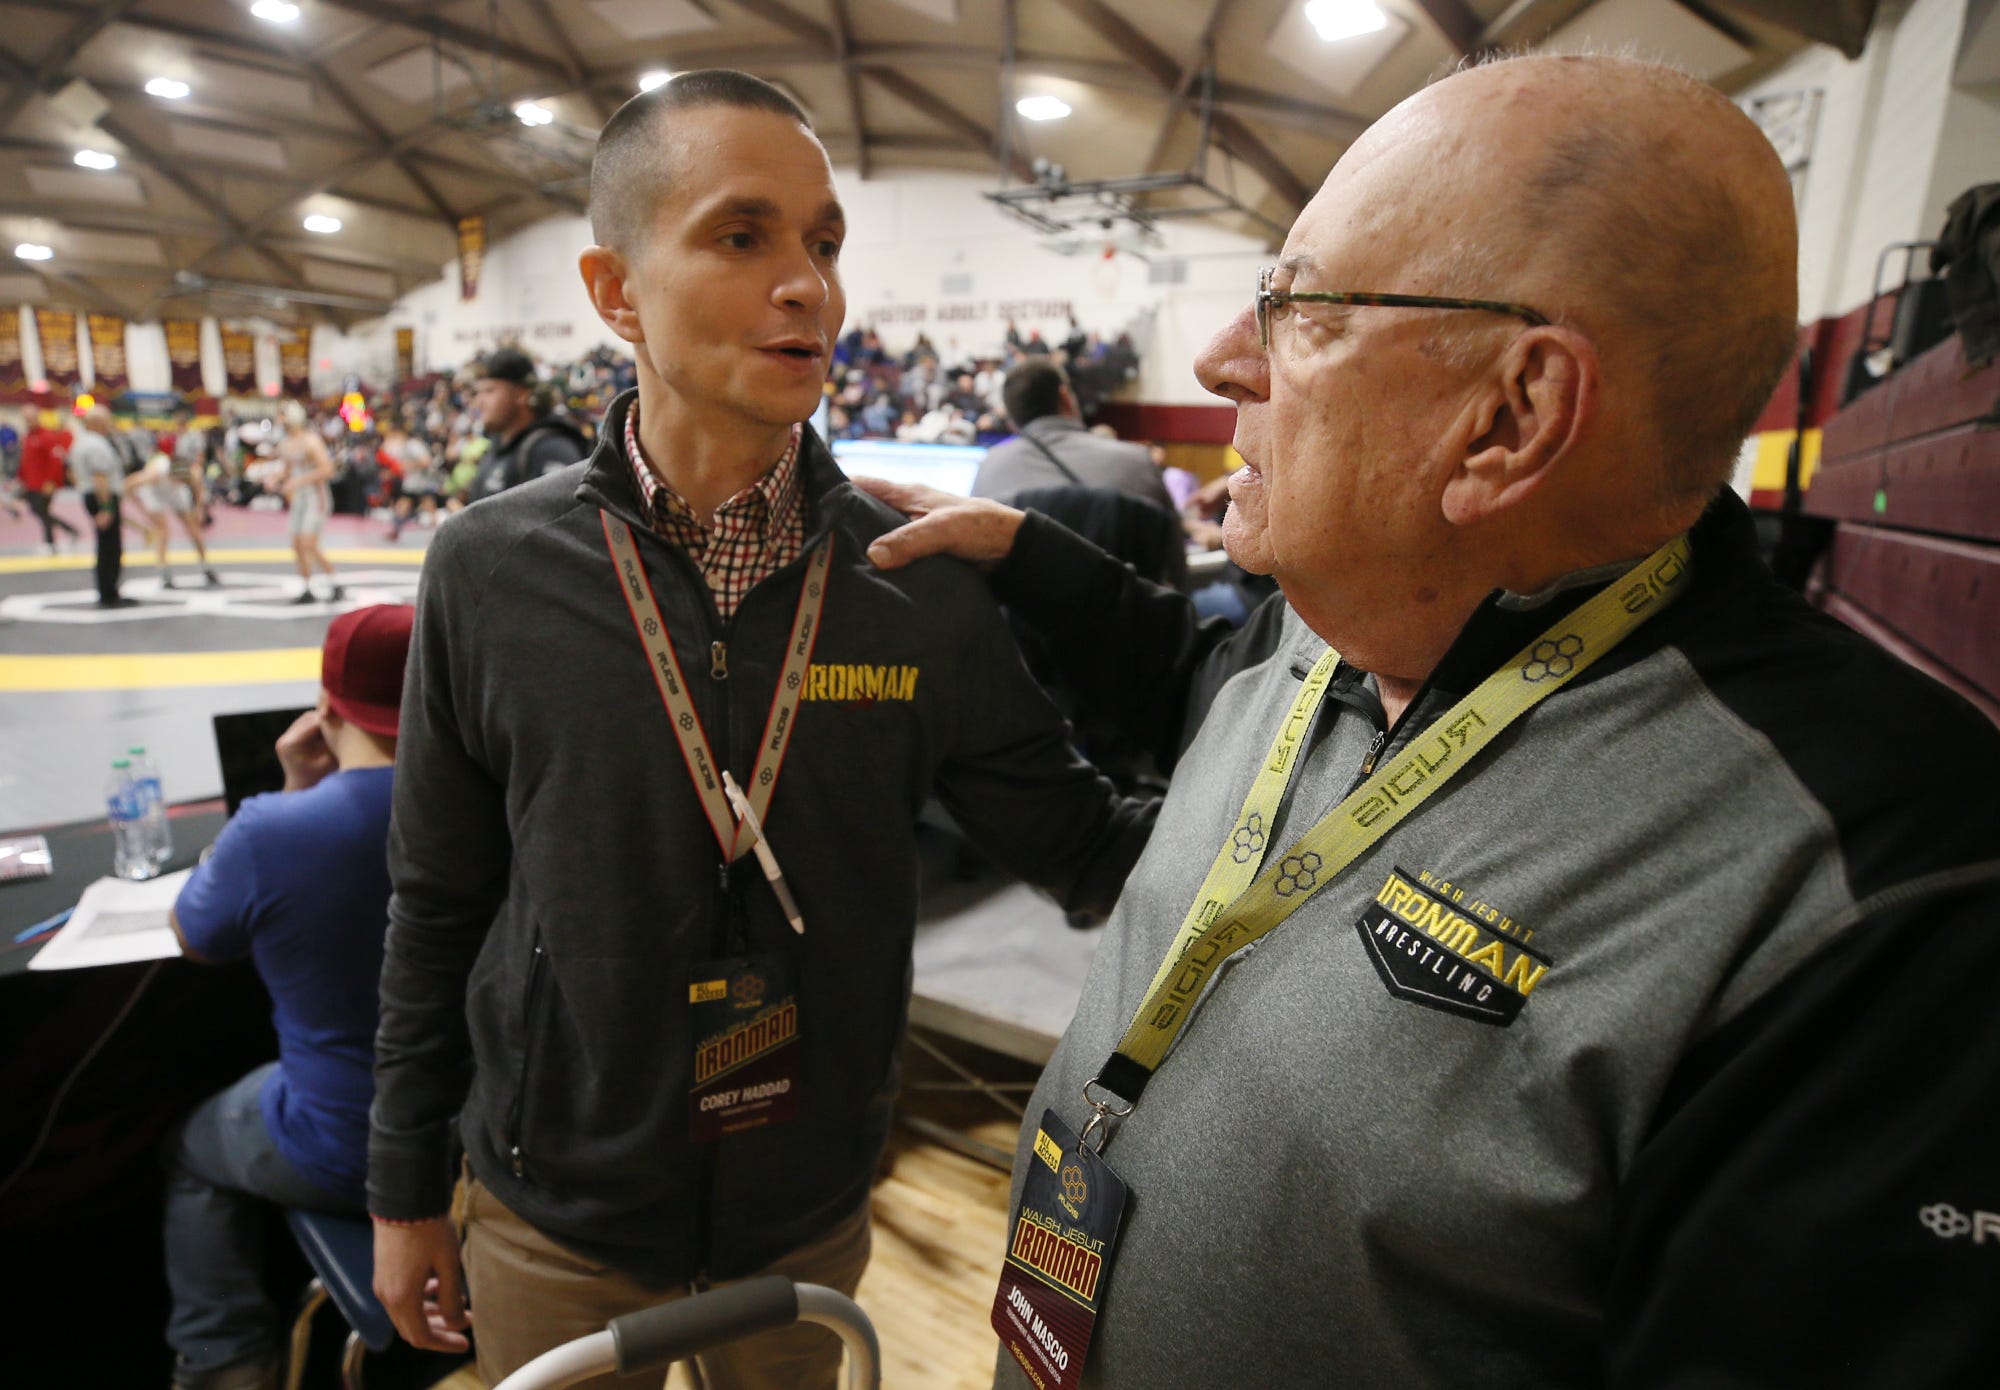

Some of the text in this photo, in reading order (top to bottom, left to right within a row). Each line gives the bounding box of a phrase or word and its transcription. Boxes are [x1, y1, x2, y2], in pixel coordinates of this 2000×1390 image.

[771, 706, 790, 751] RUDIS
[693, 746, 715, 790] RUDIS
[1376, 873, 1549, 997] IRONMAN
[1468, 900, 1535, 942] JESUIT
[1375, 918, 1492, 1002] WRESTLING
[695, 1003, 797, 1083] IRONMAN
[700, 1088, 740, 1112] COREY
[742, 1079, 791, 1102] HADDAD
[1038, 1144, 1058, 1170] ACCESS
[1040, 1134, 1050, 1150] ALL
[1058, 1193, 1079, 1219] RUDIS
[1022, 1206, 1105, 1253] WALSH JESUIT
[1011, 1217, 1102, 1302] IRONMAN
[1007, 1285, 1069, 1371] JOHN MASCIO
